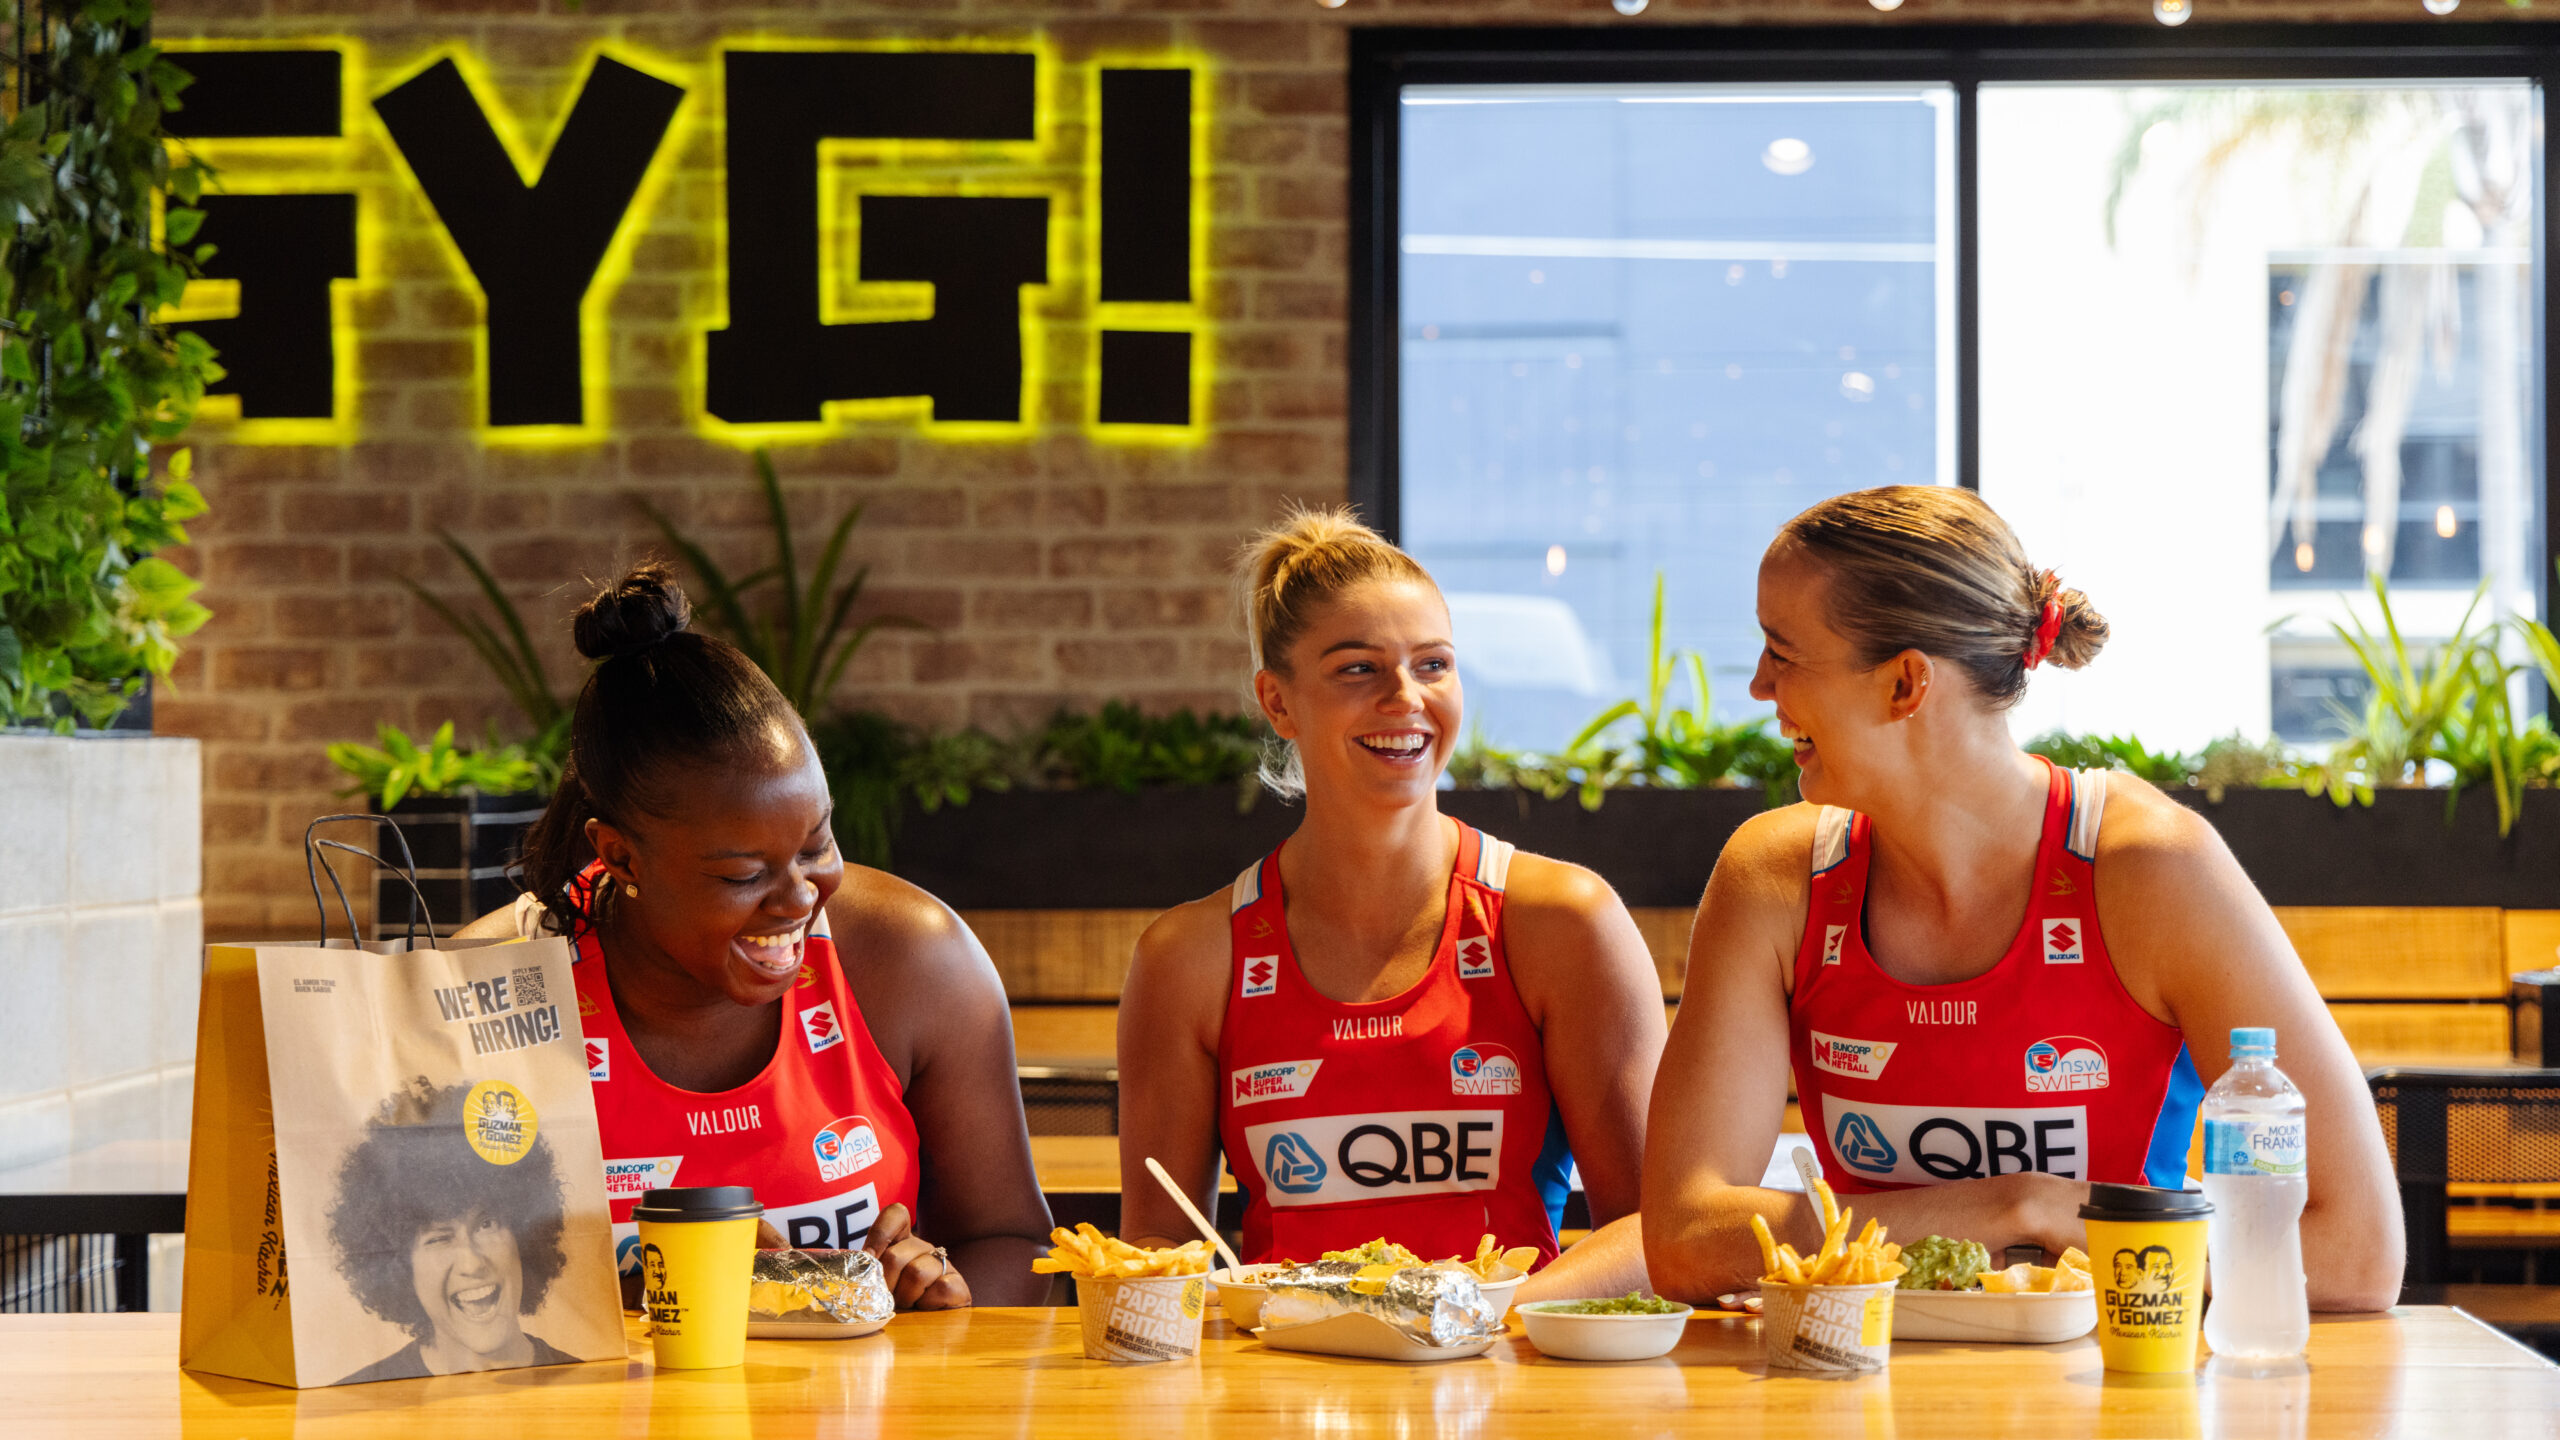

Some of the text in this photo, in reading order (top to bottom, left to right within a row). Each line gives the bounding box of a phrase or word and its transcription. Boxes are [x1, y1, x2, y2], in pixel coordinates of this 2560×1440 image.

[2048, 953, 2080, 961] SUZUKI
[1463, 968, 1492, 976] SUZUKI
[1246, 986, 1273, 994] SUZUKI
[434, 976, 512, 1021] WE'RE
[1906, 1000, 1977, 1025] VALOUR
[468, 1005, 561, 1055] HIRING!
[1333, 1015, 1403, 1041] VALOUR
[813, 1033, 840, 1049] SUZUKI
[1832, 1042, 1871, 1055] SUNCORP
[1832, 1050, 1859, 1064] SUPER
[1254, 1067, 1296, 1080] SUNCORP
[1483, 1065, 1516, 1078] nsw
[1832, 1059, 1869, 1074] NETBALL
[2060, 1059, 2102, 1073] nsw
[1254, 1076, 1283, 1089] SUPER
[1453, 1079, 1521, 1095] SWIFTS
[2027, 1072, 2108, 1092] SWIFTS
[1254, 1084, 1295, 1097] NETBALL
[478, 1116, 522, 1133] GUZMAN
[686, 1105, 762, 1136] VALOUR
[477, 1129, 522, 1145] Y GOMEZ
[844, 1133, 873, 1156] nsw
[1338, 1122, 1493, 1187] QBE
[1909, 1117, 2076, 1181] QBE
[606, 1164, 655, 1174] SUNCORP
[822, 1144, 882, 1181] SWIFTS
[606, 1173, 641, 1184] SUPER
[606, 1181, 656, 1193] NETBALL
[787, 1198, 871, 1250] BE
[257, 1231, 279, 1296] Kitchen
[647, 1289, 678, 1306] MAN
[1115, 1284, 1180, 1321] PAPAS
[2104, 1288, 2182, 1308] GUZMAN
[649, 1307, 682, 1323] MEZ
[1804, 1292, 1864, 1330] PAPA
[2106, 1308, 2184, 1326] Y GOMEZ
[1108, 1306, 1178, 1344] FRITAS
[1105, 1333, 1115, 1342] NO
[1124, 1333, 1135, 1342] ON
[1135, 1336, 1153, 1347] REAL
[1155, 1342, 1179, 1354] POTATO
[1824, 1345, 1842, 1357] REAL
